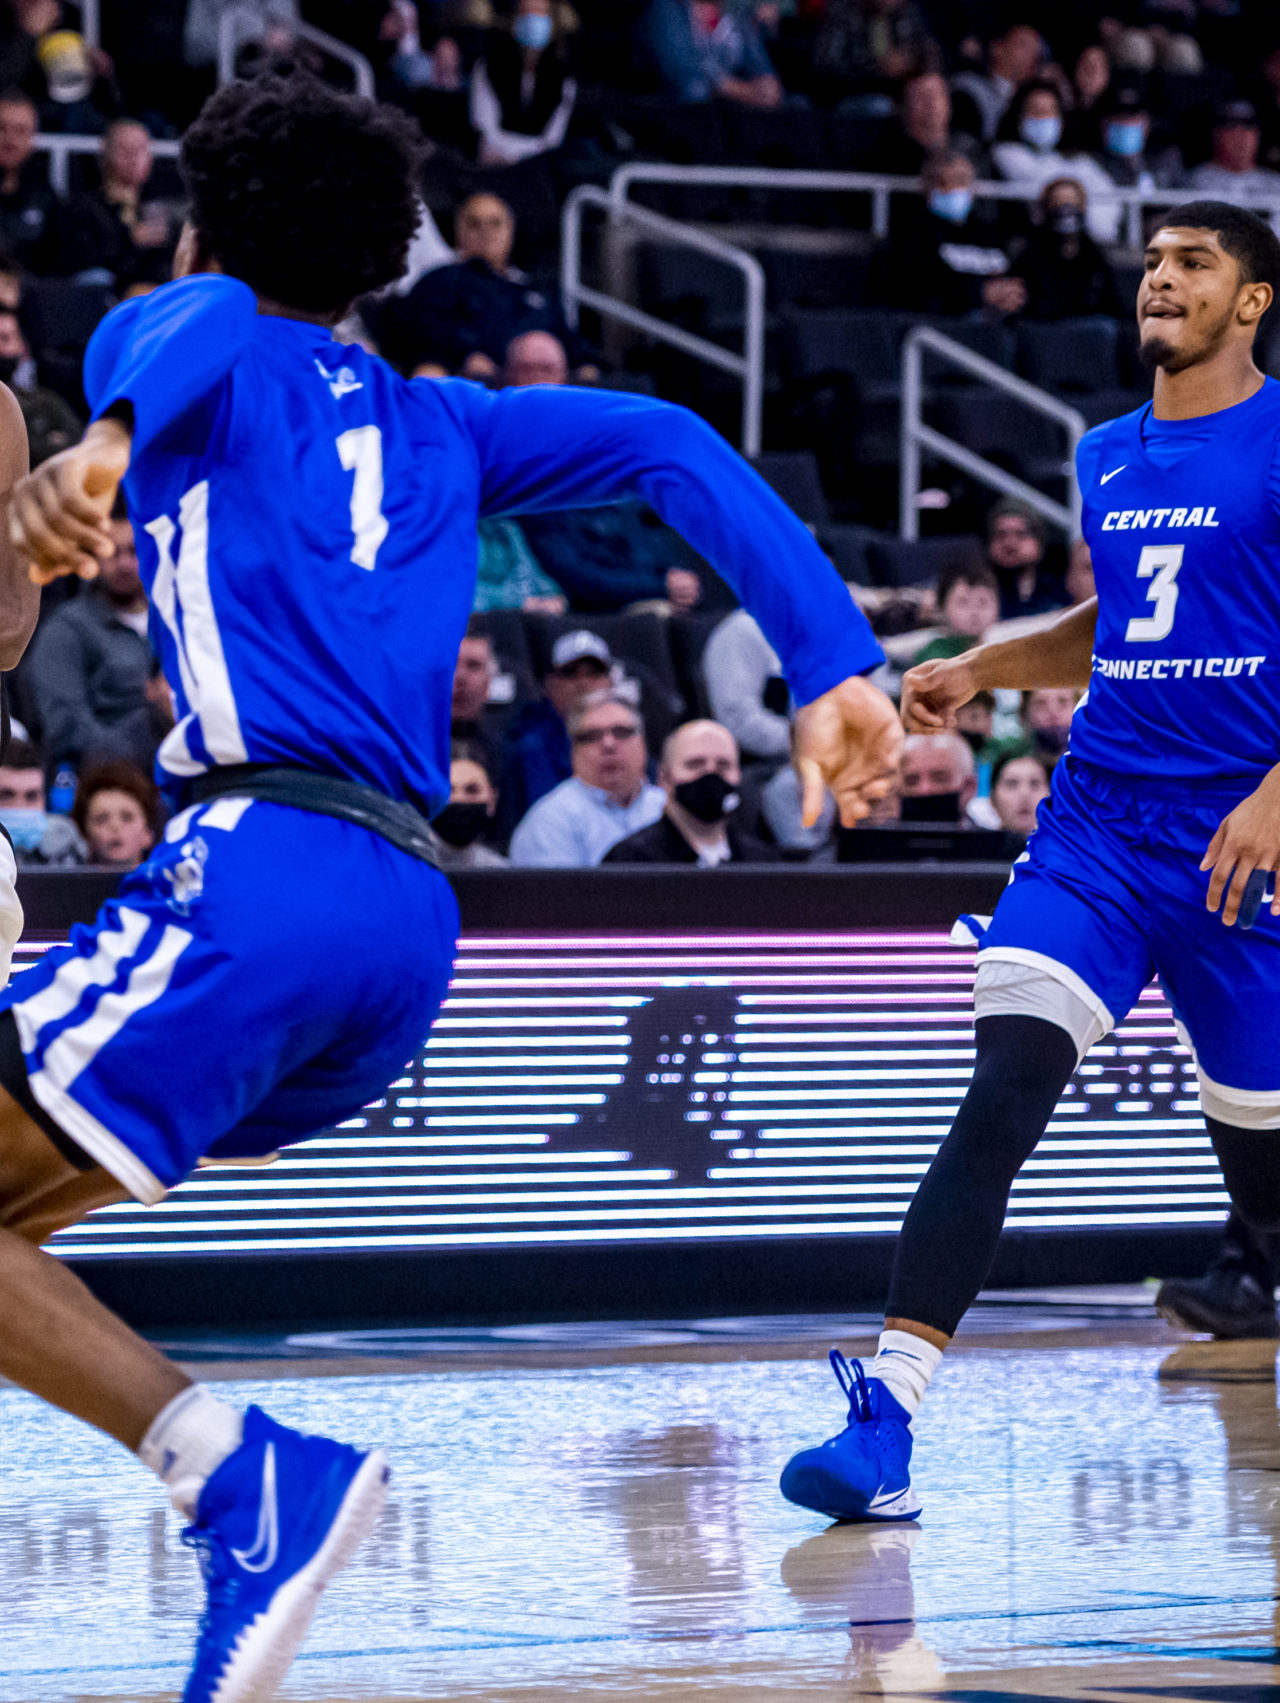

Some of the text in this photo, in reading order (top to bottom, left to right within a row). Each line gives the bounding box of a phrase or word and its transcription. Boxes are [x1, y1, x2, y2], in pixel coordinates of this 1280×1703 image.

[336, 424, 389, 571] 1
[1101, 506, 1220, 531] CENTRAL
[1124, 544, 1185, 642] 3
[1091, 654, 1266, 680] ONNECTICUT
